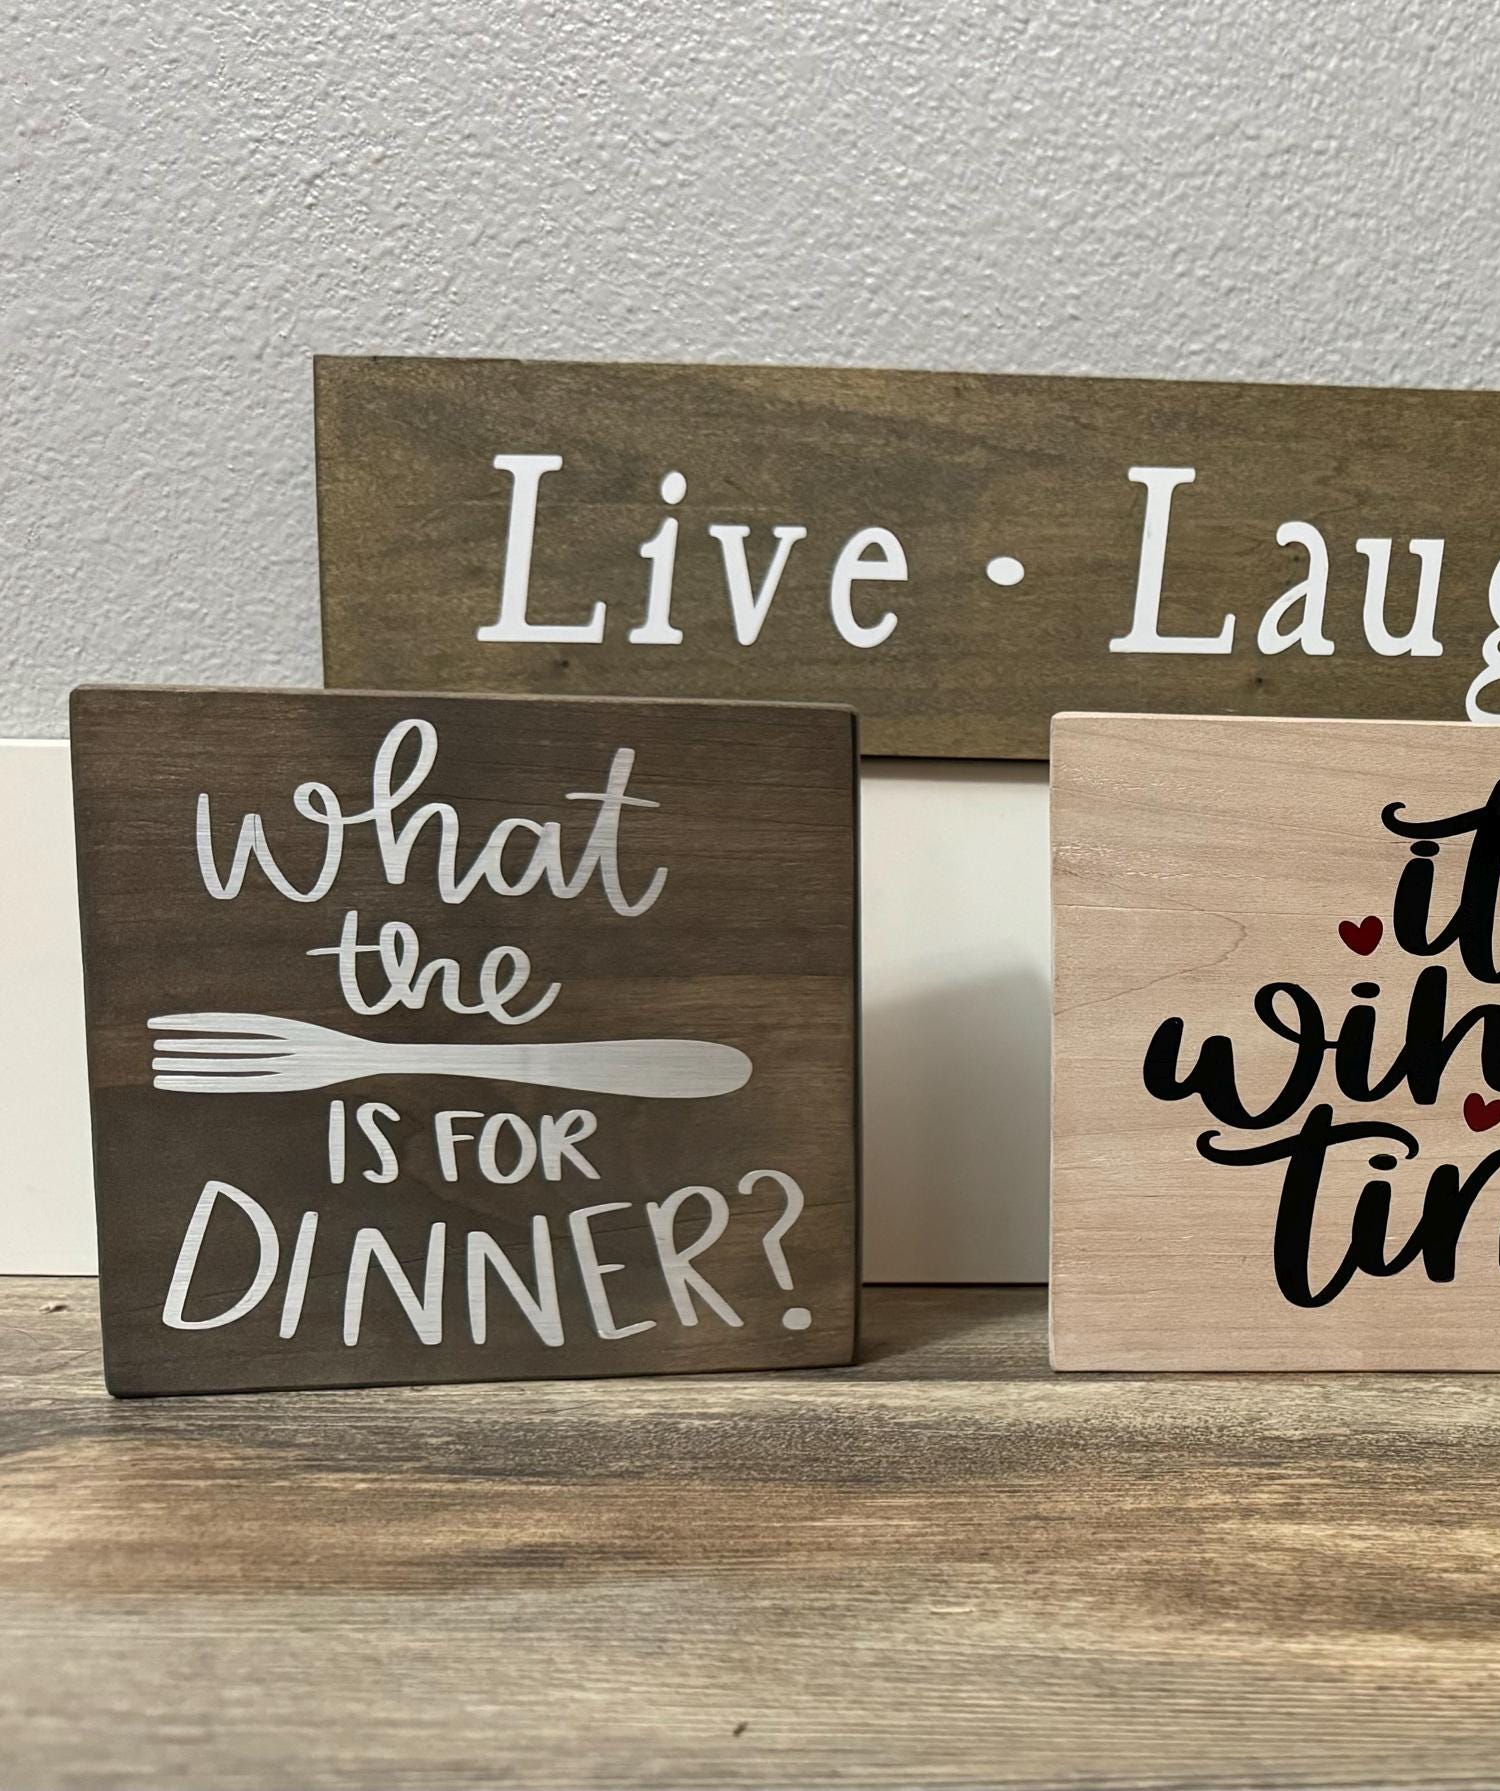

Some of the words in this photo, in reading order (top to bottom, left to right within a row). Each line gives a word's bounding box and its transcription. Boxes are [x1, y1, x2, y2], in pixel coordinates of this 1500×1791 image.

[477, 454, 908, 649] Live
[306, 910, 562, 1025] the
[328, 1100, 401, 1184] IS
[435, 1108, 601, 1184] FOR
[161, 1169, 812, 1347] DINNER?
